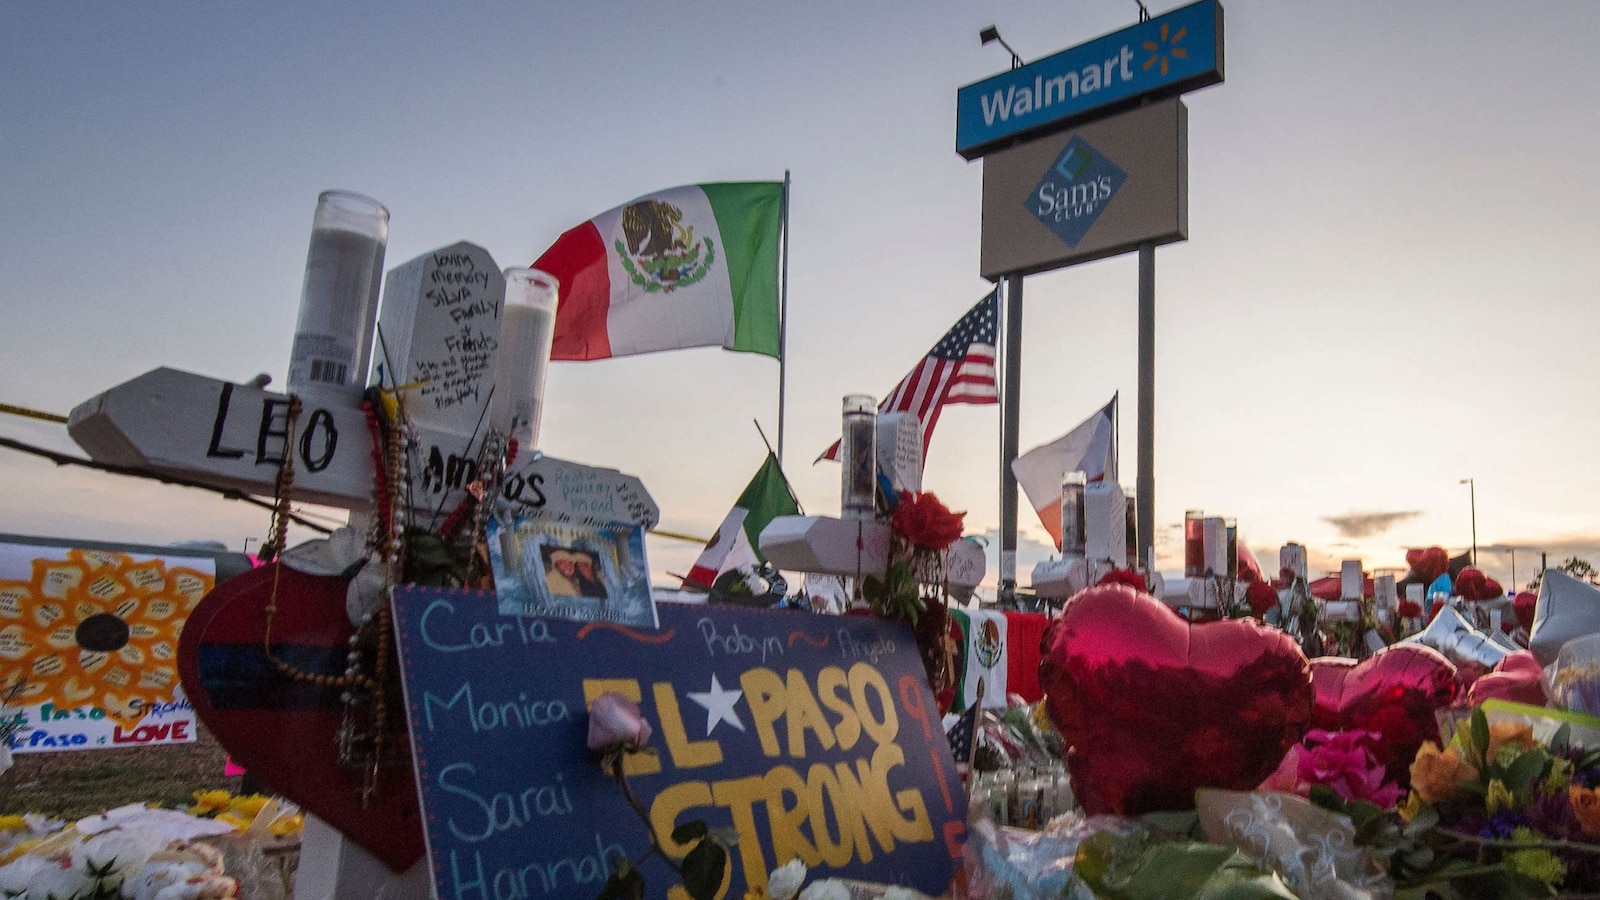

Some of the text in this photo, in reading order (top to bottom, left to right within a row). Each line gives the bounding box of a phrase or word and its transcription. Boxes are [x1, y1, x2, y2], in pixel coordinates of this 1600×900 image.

[980, 45, 1134, 127] Walmart
[1038, 174, 1111, 217] Sam's
[1055, 203, 1093, 222] CLUB
[207, 382, 338, 473] LEO
[420, 598, 559, 653] Carla
[697, 616, 784, 664] Robyn
[112, 720, 190, 744] LOVE
[423, 682, 571, 733] Monica
[739, 661, 899, 759] PASO
[438, 761, 574, 843] Sarai
[649, 743, 935, 900] STRONG
[450, 832, 628, 900] Hannah
